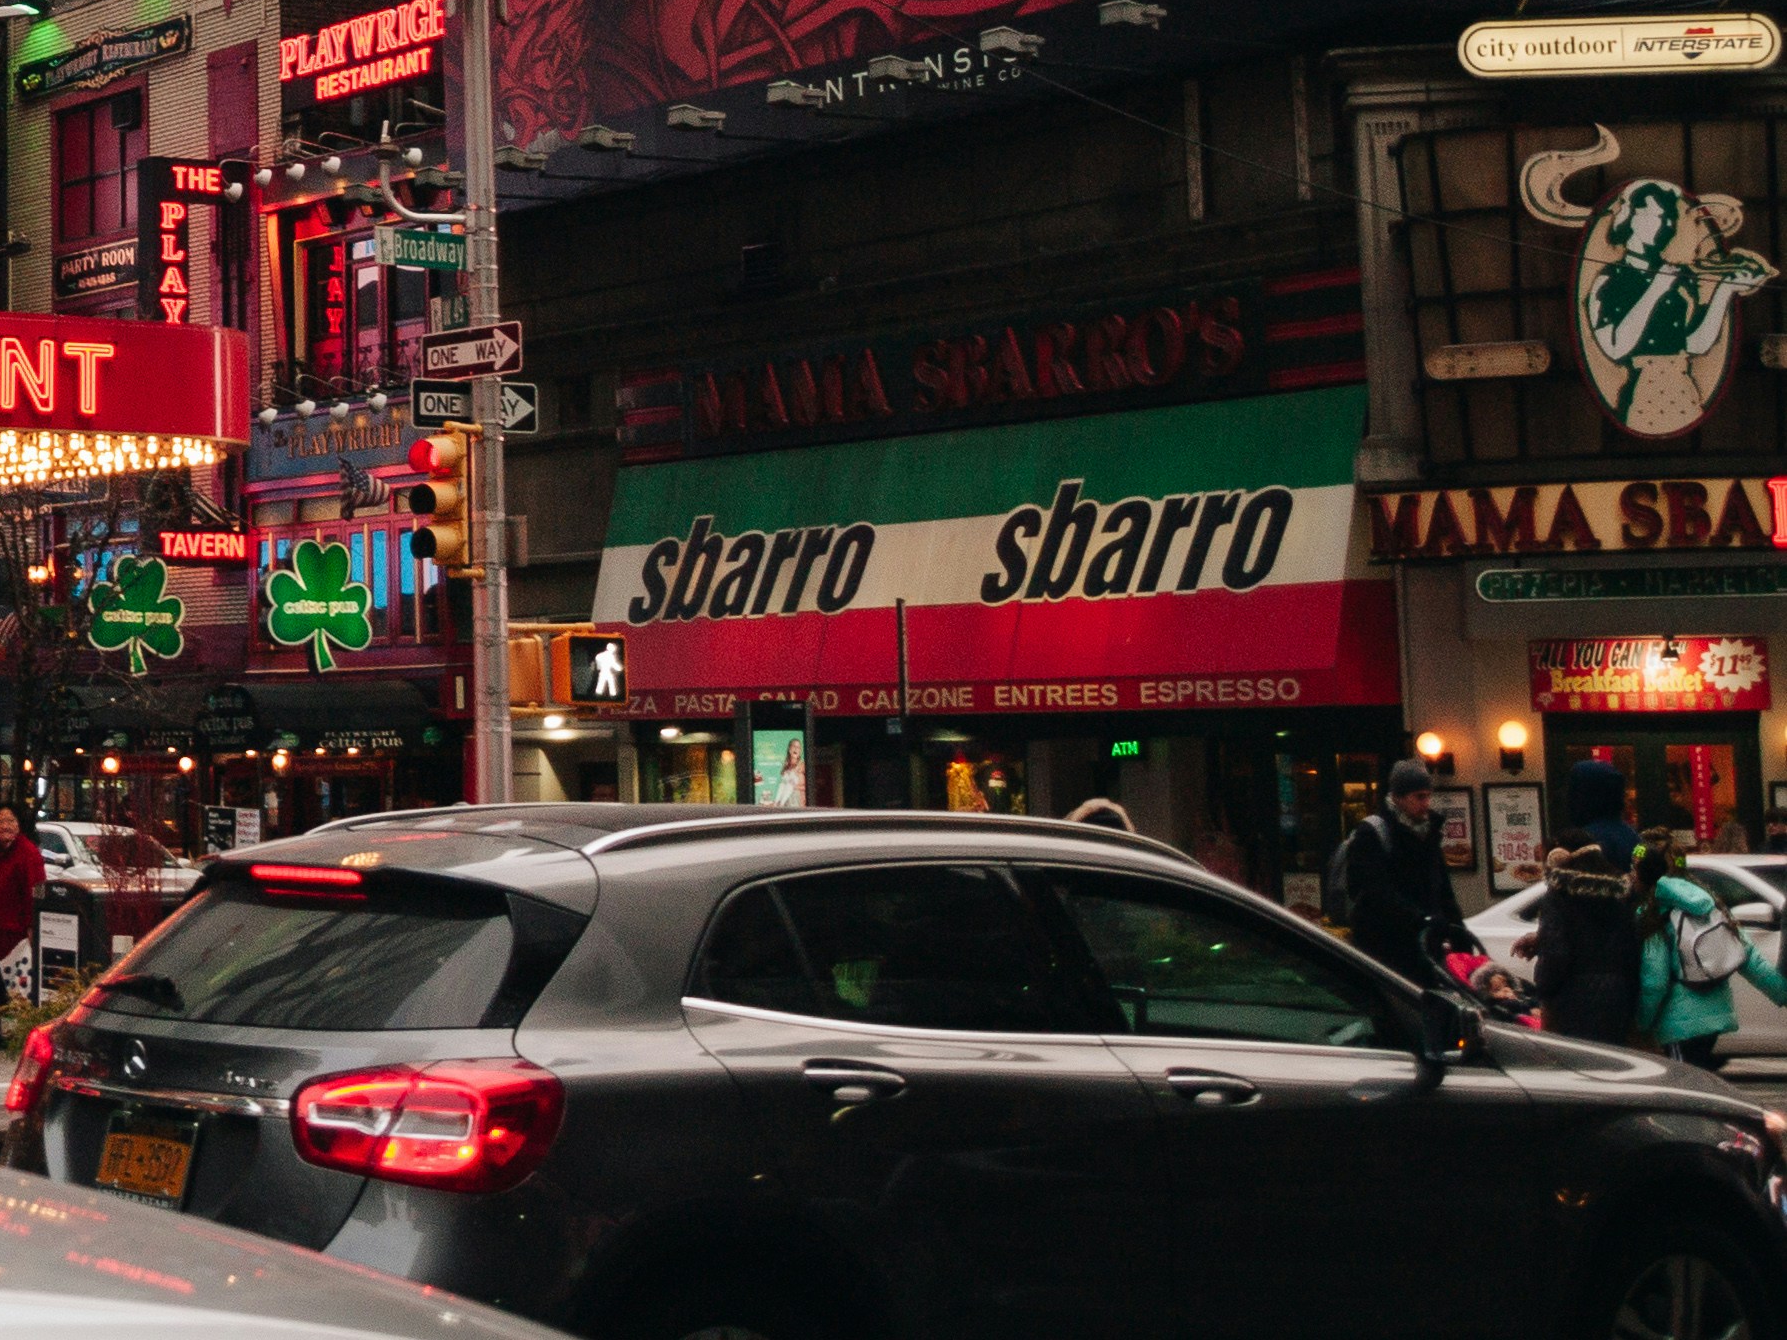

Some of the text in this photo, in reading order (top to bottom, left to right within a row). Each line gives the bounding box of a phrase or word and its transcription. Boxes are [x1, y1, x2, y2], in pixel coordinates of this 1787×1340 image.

[1477, 39, 1519, 62] city
[1525, 36, 1618, 57] outdoor
[315, 47, 432, 100] RESTAURANT
[808, 47, 1018, 104] NTNSI
[171, 165, 222, 193] THE
[61, 255, 96, 280] PARTY
[101, 246, 135, 267] ROOM
[394, 233, 465, 270] Broadway
[430, 340, 507, 369] ONE WAY
[423, 394, 462, 414] ONE
[1367, 483, 1602, 556] MAMA
[159, 532, 245, 558] TAVERN
[628, 478, 1294, 628] sbarro sbarro
[1571, 641, 1607, 670] YOU
[1550, 665, 1703, 693] Breakfast Buffet
[674, 692, 737, 713] PASTA
[857, 687, 974, 710] CALZONE
[993, 684, 1118, 707] ENTREES
[1139, 677, 1301, 704] ESPRESSO
[1112, 741, 1139, 756] ATM
